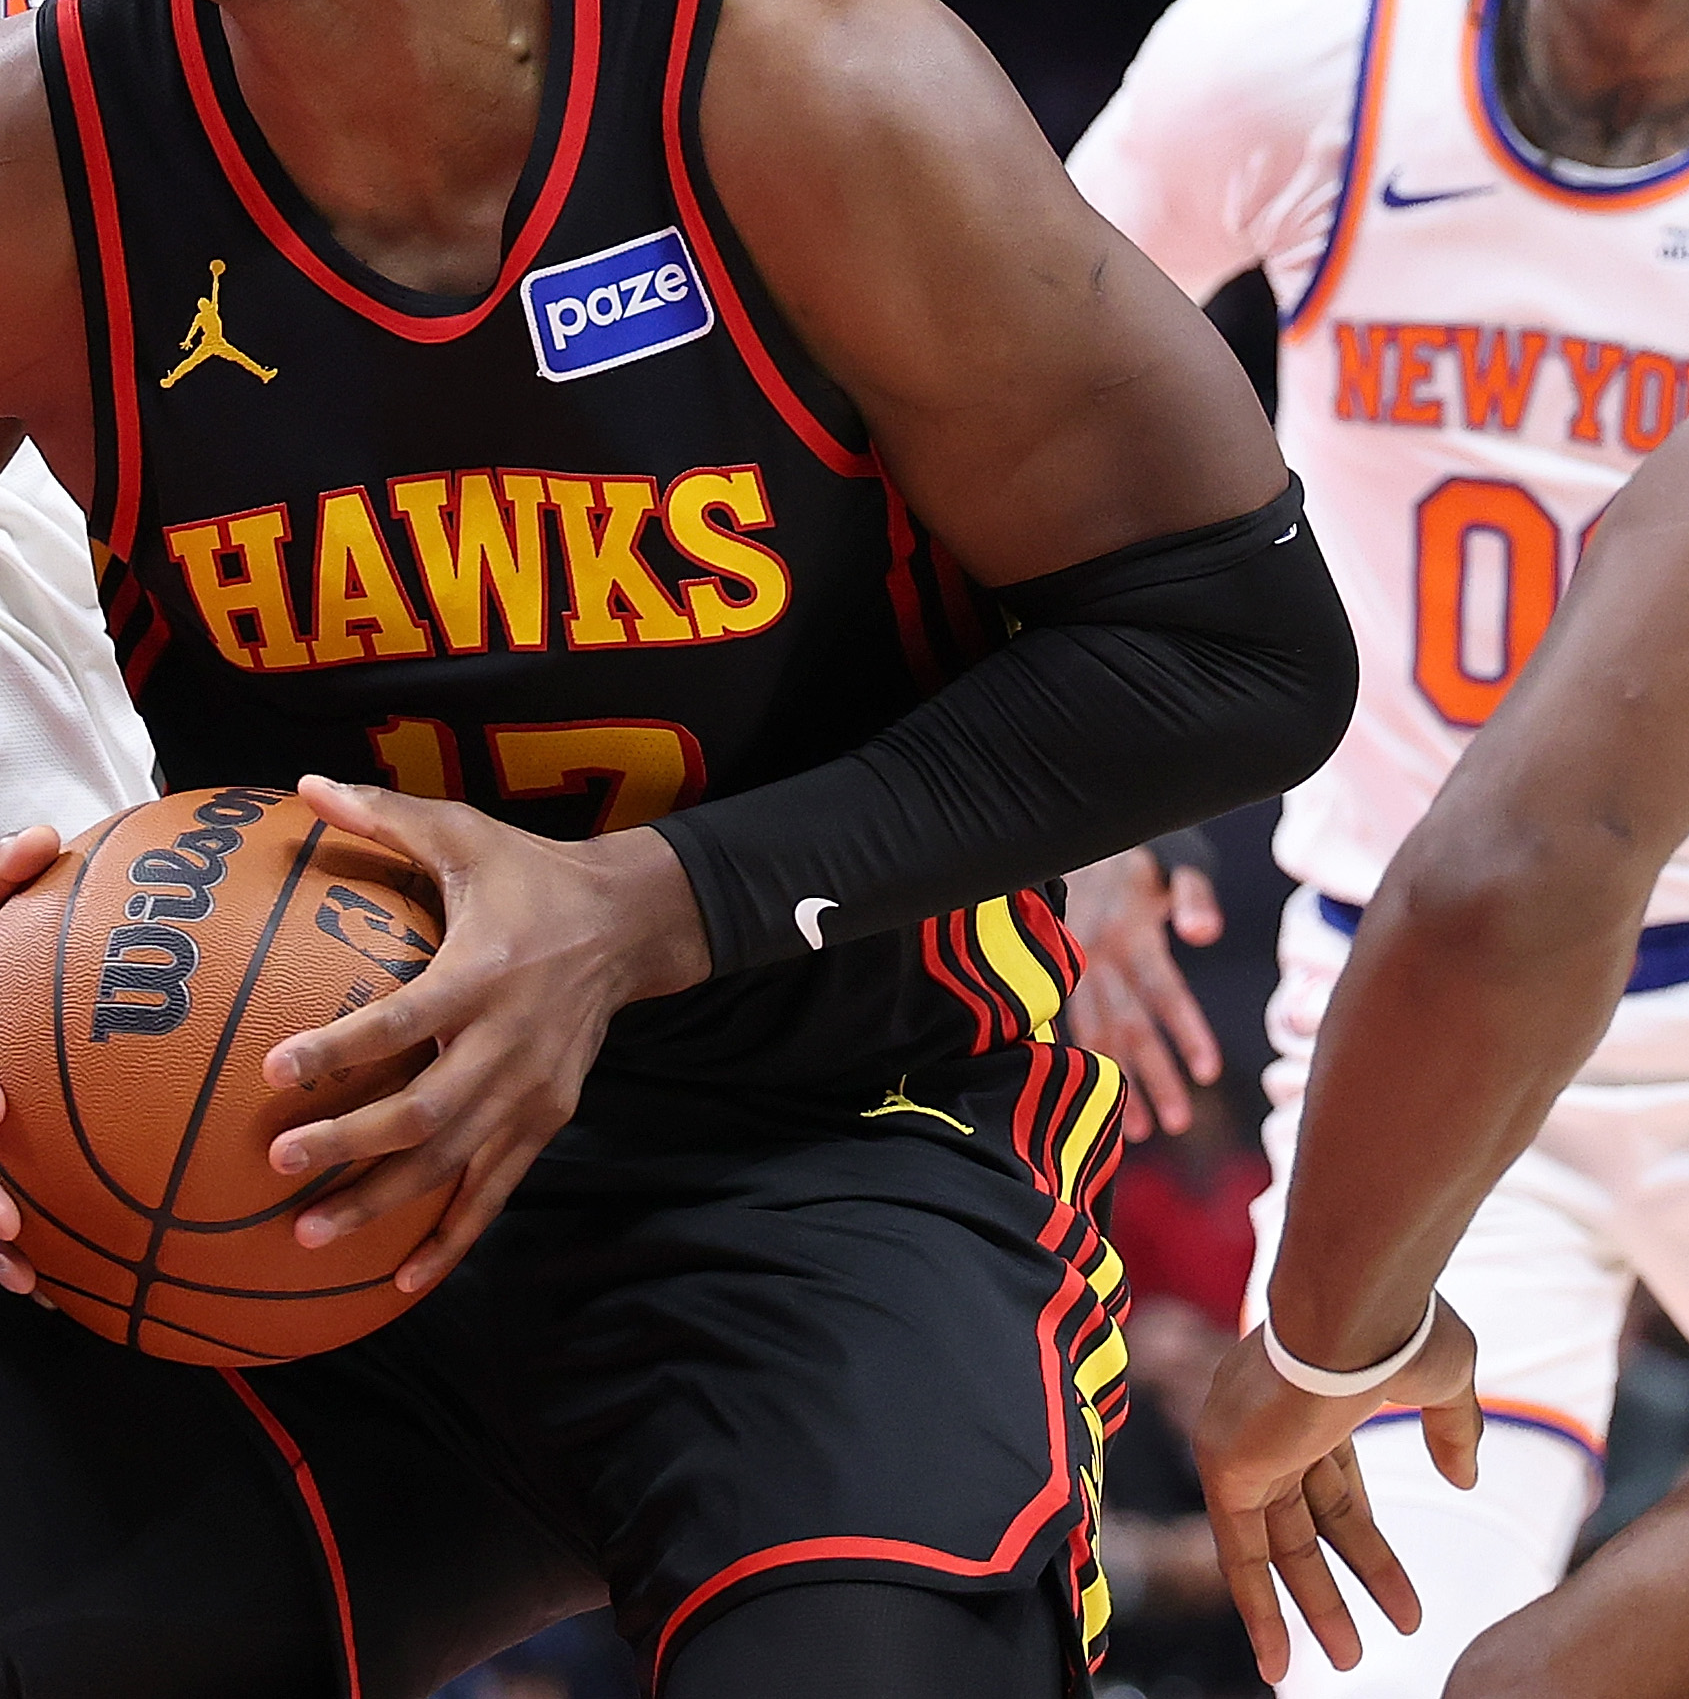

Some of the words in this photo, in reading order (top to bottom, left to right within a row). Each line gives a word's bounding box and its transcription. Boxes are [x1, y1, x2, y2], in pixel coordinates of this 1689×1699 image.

[545, 263, 689, 351] paze
[1334, 321, 1549, 433] NEW
[162, 463, 792, 674] HAWKS
[1412, 476, 1615, 729] 0
[91, 787, 299, 1043] Wilson
